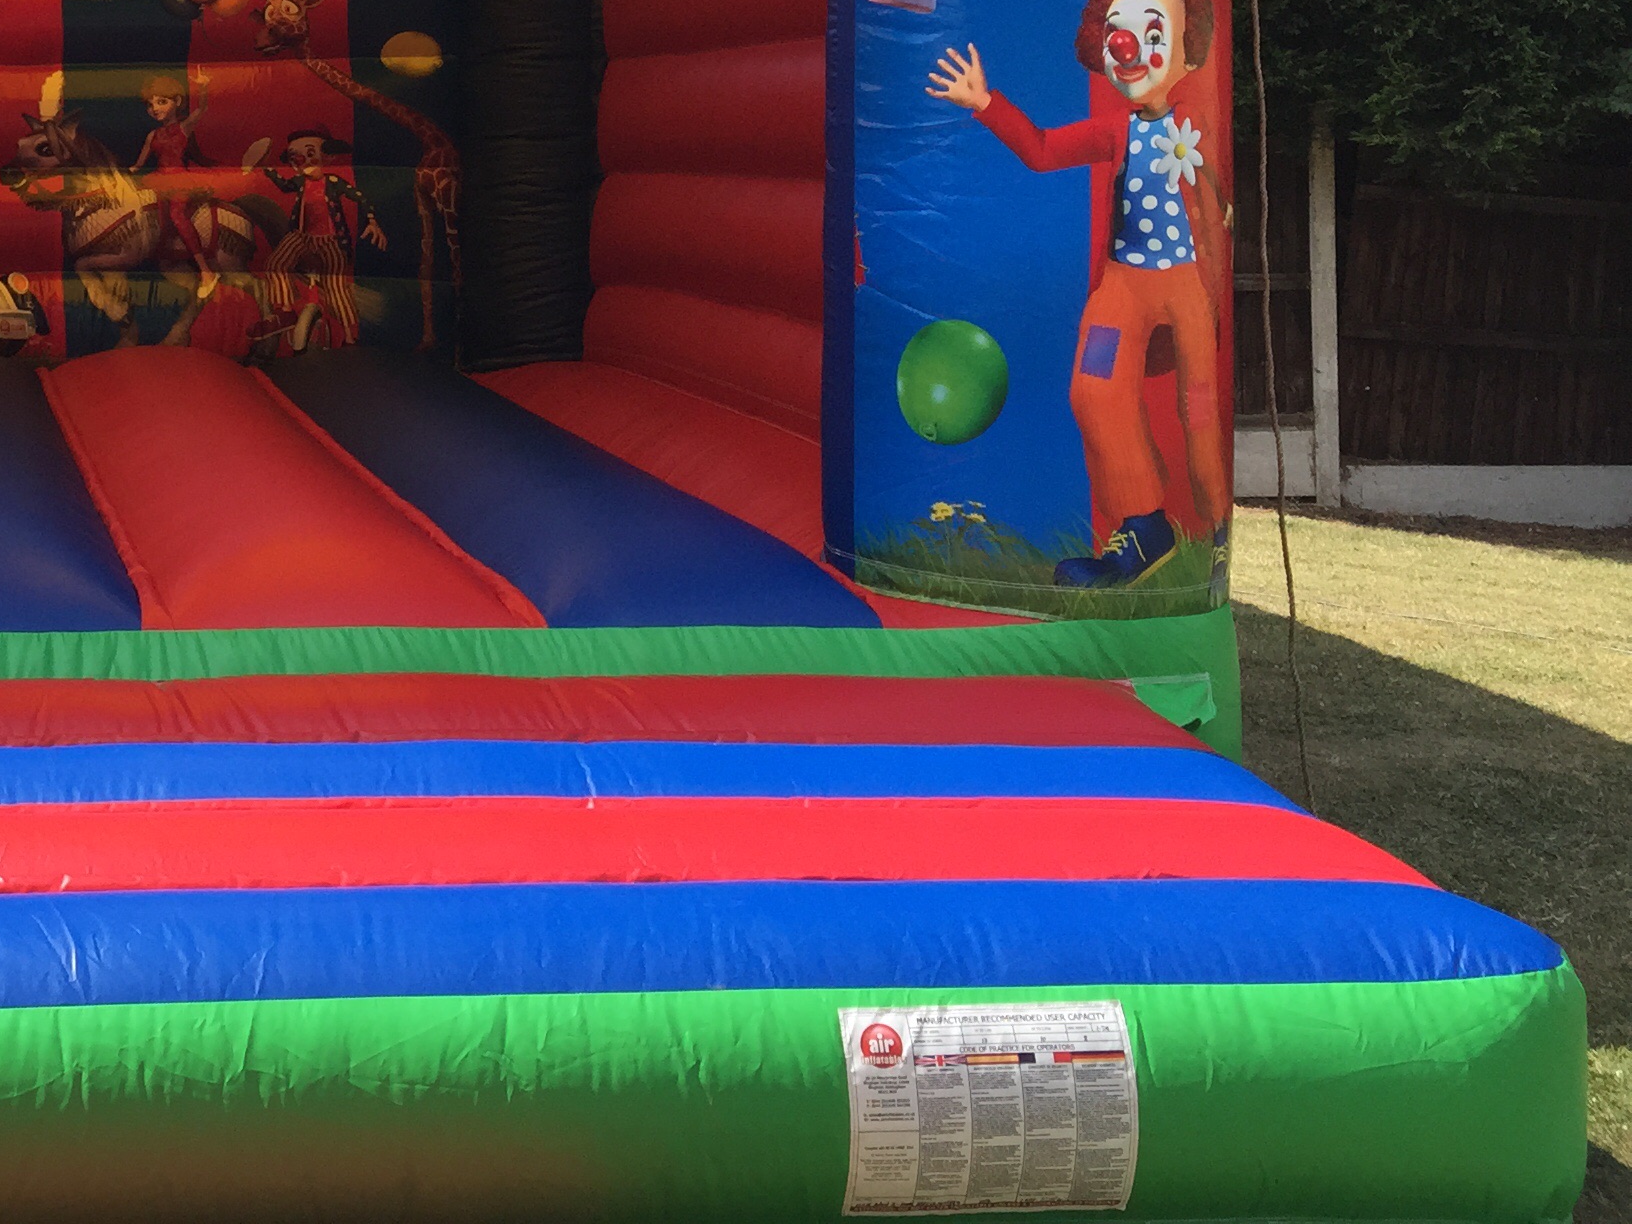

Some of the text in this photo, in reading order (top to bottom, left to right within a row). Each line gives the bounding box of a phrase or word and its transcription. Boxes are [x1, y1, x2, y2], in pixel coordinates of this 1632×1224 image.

[917, 1013, 1106, 1025] MANUFACTURER RECOMMENDED USER CAPACITY
[869, 1033, 894, 1053] air
